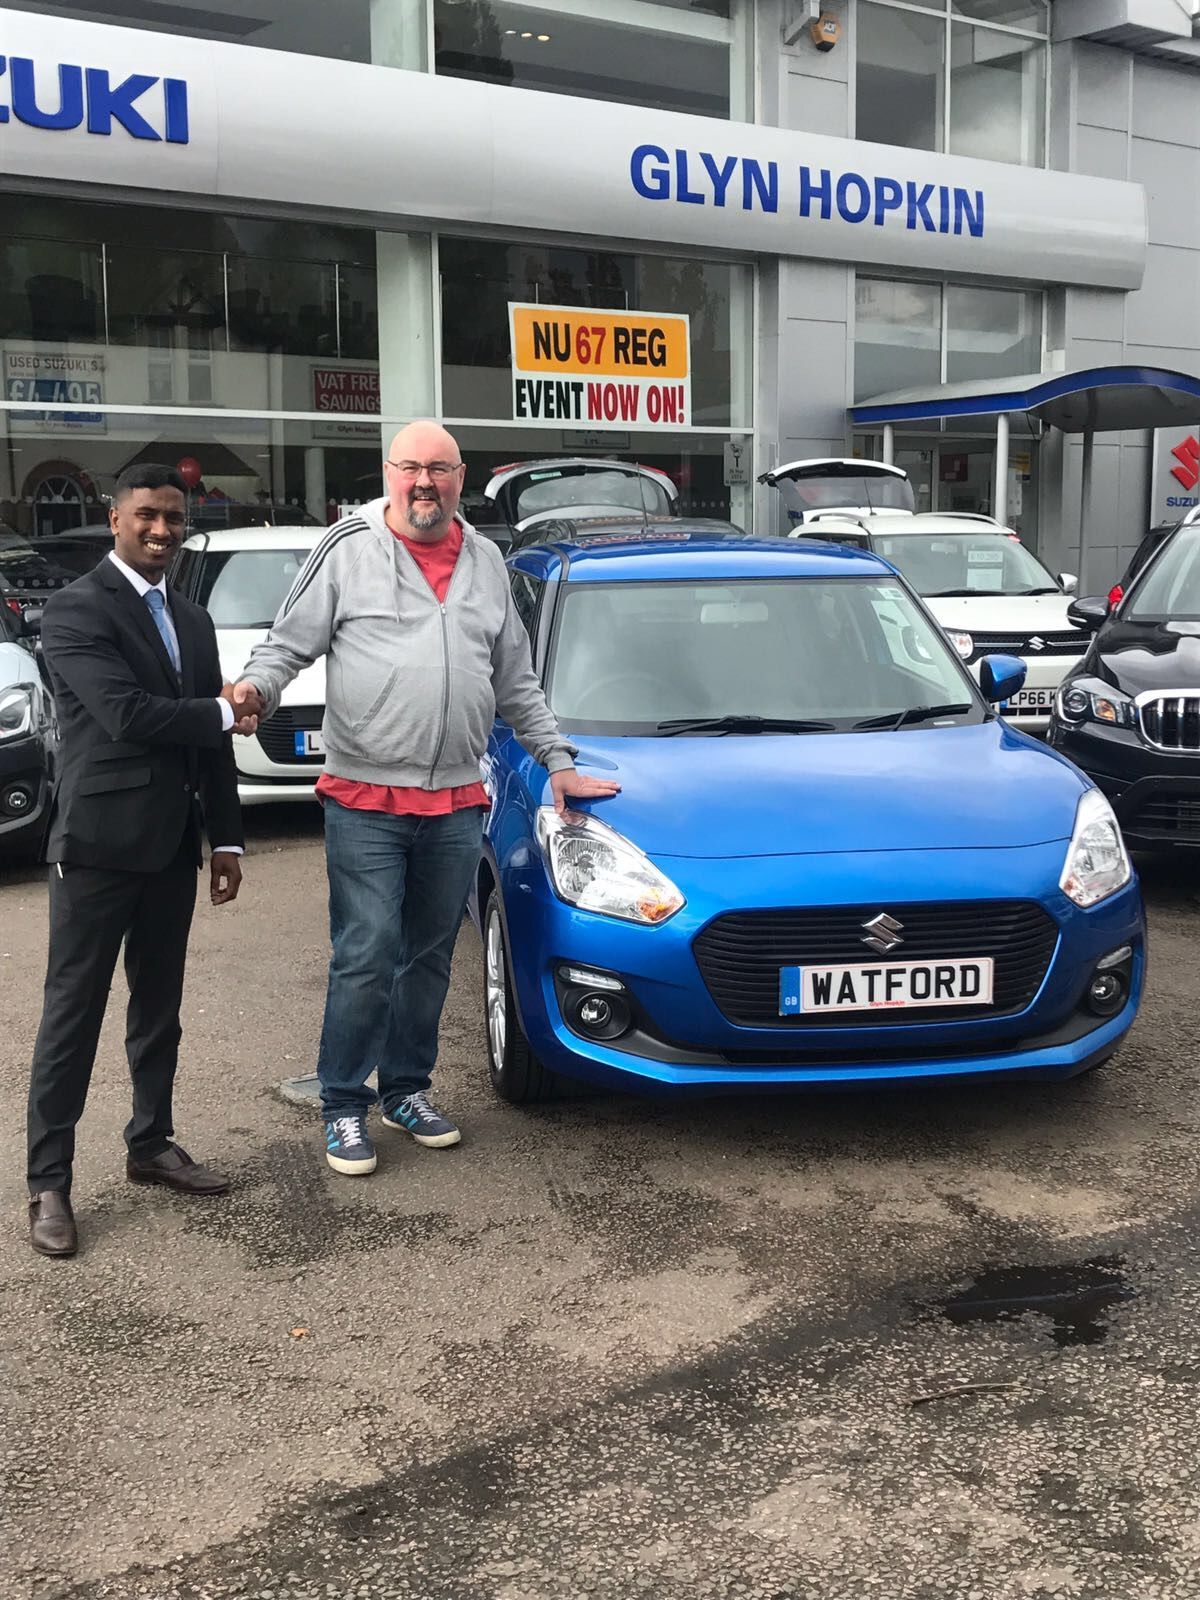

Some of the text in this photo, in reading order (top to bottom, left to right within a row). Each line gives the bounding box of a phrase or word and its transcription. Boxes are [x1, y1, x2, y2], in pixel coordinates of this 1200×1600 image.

[630, 144, 984, 238] GLYN HOPKIN
[533, 321, 667, 367] NU 67 REG
[9, 356, 99, 372] USED SUZUKI'S
[317, 373, 380, 391] VAT FRE
[515, 379, 685, 424] EVENT NOW ON!
[1009, 692, 1046, 706] LP66
[811, 964, 981, 1005] WATFORD
[784, 996, 798, 1006] GB
